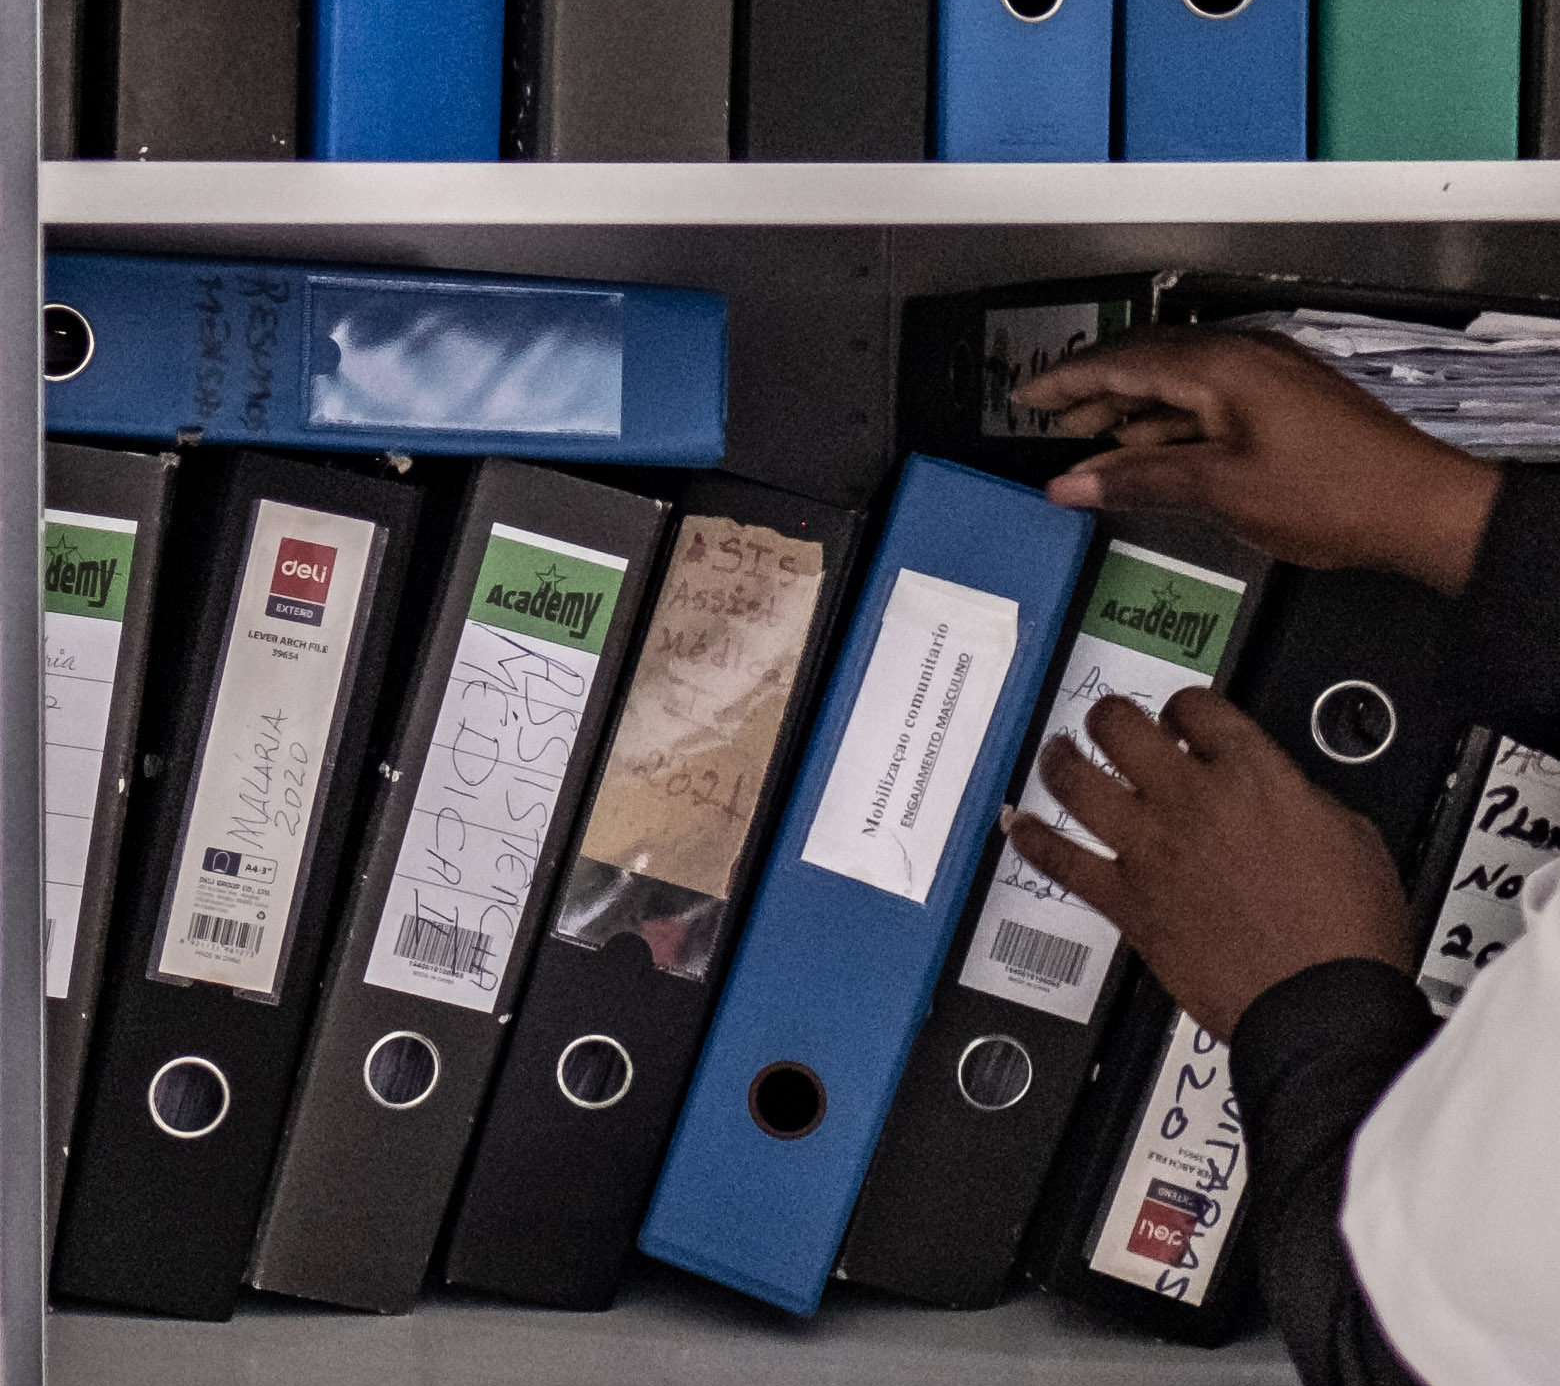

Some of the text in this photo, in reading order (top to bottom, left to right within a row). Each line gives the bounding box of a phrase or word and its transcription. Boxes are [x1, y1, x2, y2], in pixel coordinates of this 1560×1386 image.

[46, 556, 118, 608] demy
[281, 560, 328, 585] deli
[275, 603, 314, 620] EXTEND
[485, 580, 604, 640] Academy
[1099, 597, 1220, 659] Academy
[904, 622, 950, 729] comunitario
[900, 651, 973, 830] ENGAJAMENTO MASCULINO
[274, 741, 309, 837] 2020
